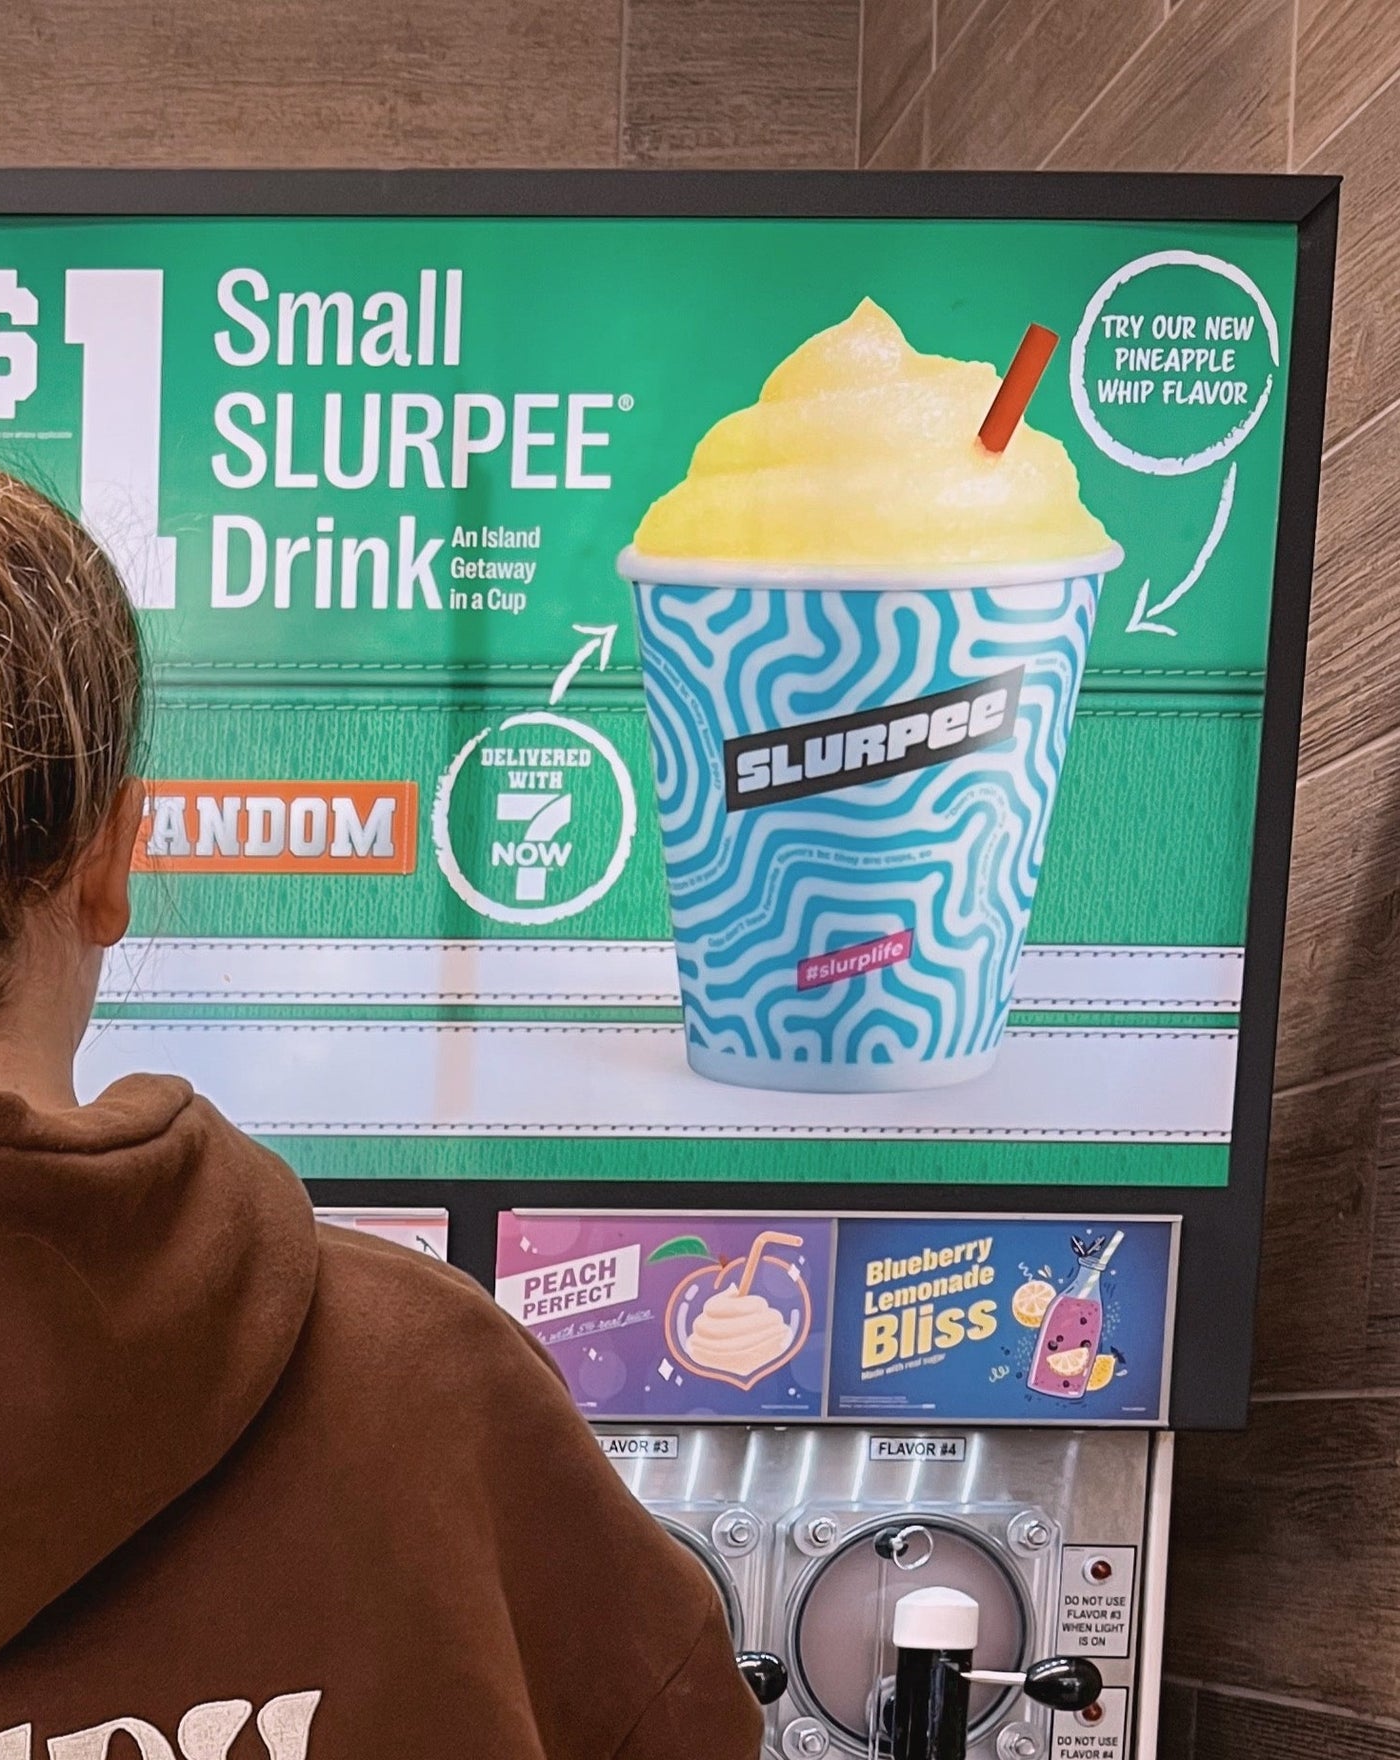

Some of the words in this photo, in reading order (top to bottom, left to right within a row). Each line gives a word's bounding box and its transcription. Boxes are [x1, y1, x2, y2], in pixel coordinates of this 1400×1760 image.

[213, 267, 463, 366] Small
[1101, 314, 1144, 339] TRY
[1151, 314, 1197, 340] OUR
[1205, 315, 1255, 341] NEW
[1115, 347, 1236, 373] PINEAPPLE
[1097, 378, 1155, 405] WHIP
[1162, 380, 1248, 405] FLAVOR
[451, 525, 478, 548] An
[481, 525, 542, 549] Island
[210, 515, 446, 611] Drink
[450, 556, 537, 584] Getaway
[449, 588, 468, 610] in
[471, 592, 484, 610] a
[487, 587, 527, 616] Cup
[736, 687, 1009, 795] SLURPEE
[481, 747, 592, 767] DELIVERED
[507, 770, 563, 789] WITH
[142, 796, 397, 859] ANDOM
[491, 841, 573, 867] NOW
[805, 939, 905, 983] #slurplife
[865, 1236, 994, 1287] Blueberry
[523, 1256, 617, 1300] PEACH
[864, 1264, 996, 1316] Lemonade
[522, 1281, 616, 1320] PERFECT
[861, 1299, 998, 1369] Bliss
[652, 1440, 670, 1453] #3
[878, 1442, 936, 1456] FLAVOR
[940, 1442, 957, 1457] #4
[1064, 1596, 1079, 1605] DO
[1082, 1596, 1103, 1606] NOT
[1105, 1596, 1126, 1606] USE
[1067, 1609, 1107, 1619] FLAVOR
[1062, 1623, 1092, 1632] WHEN
[1094, 1623, 1124, 1633] LIGHT
[1078, 1637, 1088, 1646] IS
[1091, 1637, 1105, 1646] ON
[1057, 1736, 1072, 1745] DO
[1075, 1736, 1096, 1746] NOT
[1098, 1737, 1118, 1746] USE
[1060, 1749, 1100, 1759] FLAVOR
[1102, 1750, 1113, 1759] #4
